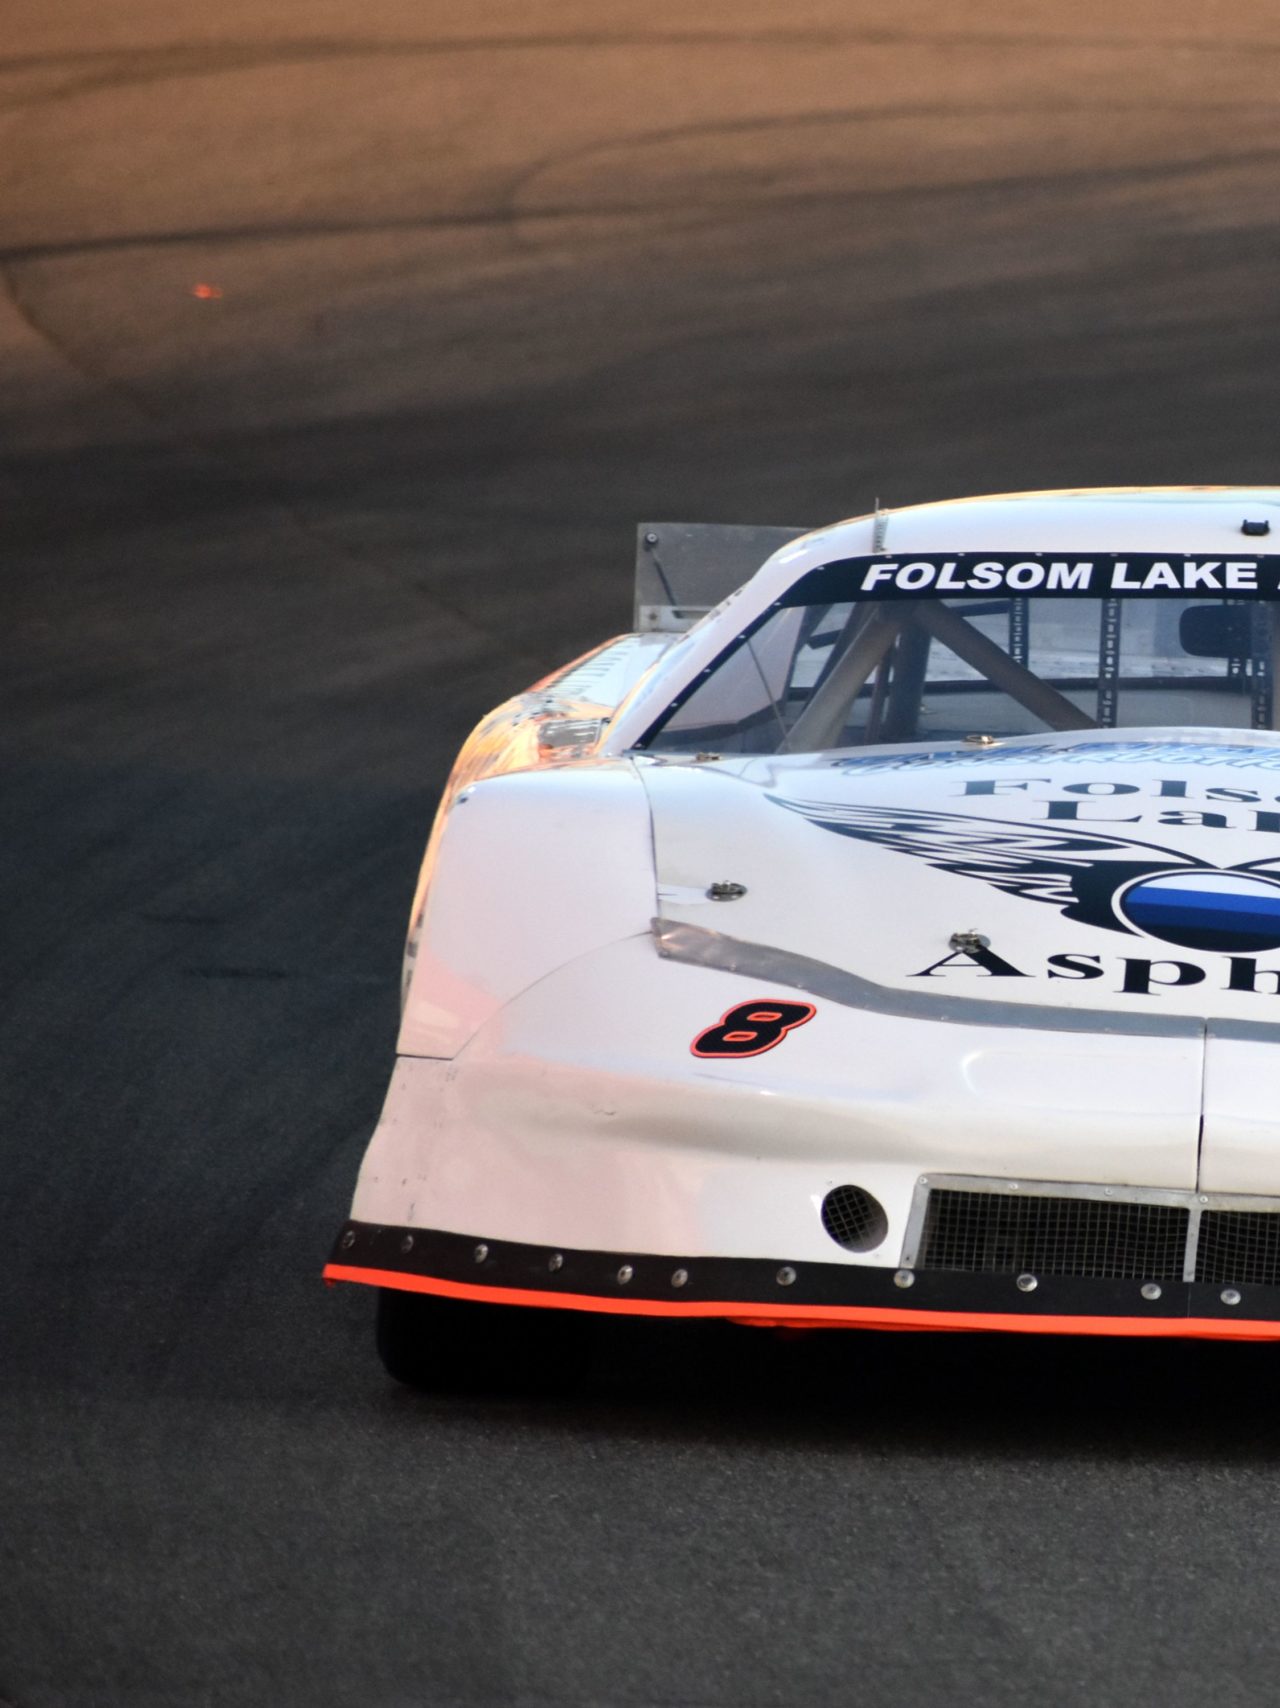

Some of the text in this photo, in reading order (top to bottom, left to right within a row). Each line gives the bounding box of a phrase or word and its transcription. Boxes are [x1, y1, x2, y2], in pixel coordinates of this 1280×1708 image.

[861, 562, 1093, 591] FOLSOM
[1110, 562, 1257, 590] LAKE
[690, 999, 817, 1058] 8
